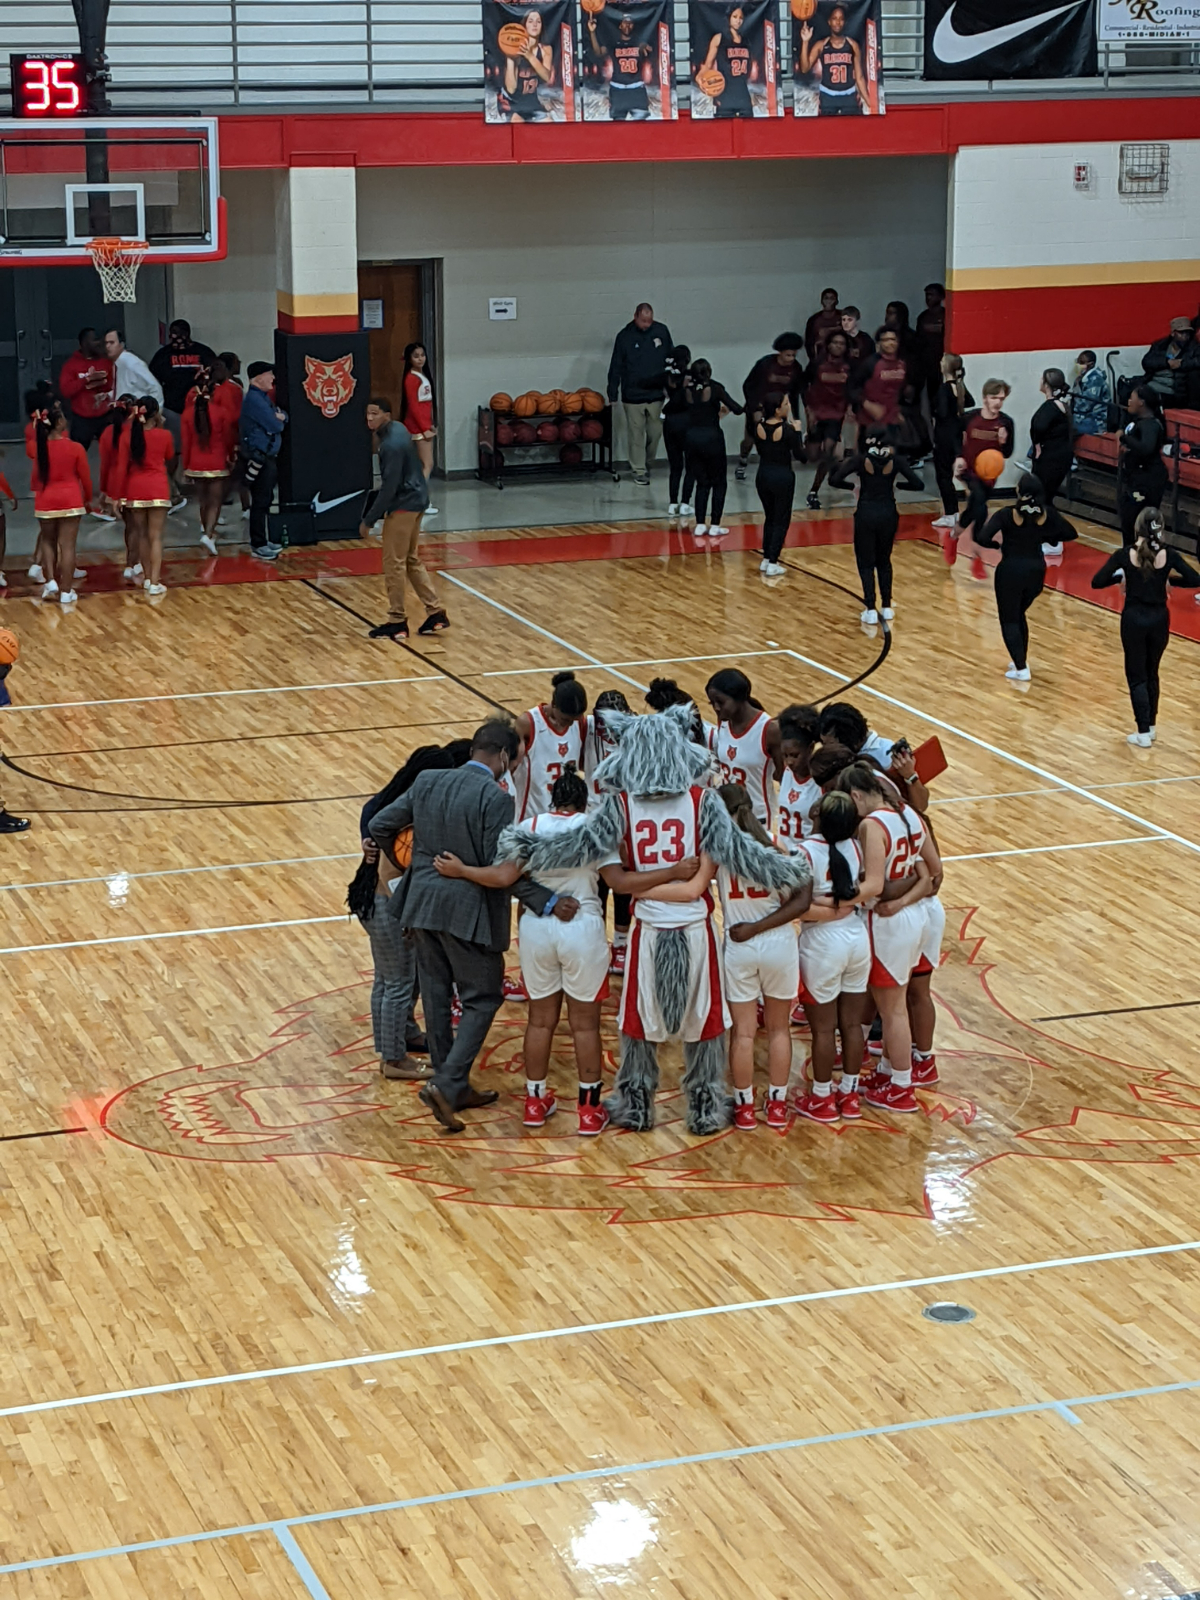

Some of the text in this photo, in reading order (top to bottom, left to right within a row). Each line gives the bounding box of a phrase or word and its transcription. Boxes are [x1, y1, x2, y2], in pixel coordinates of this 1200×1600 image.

[619, 58, 638, 73] 20
[731, 59, 747, 76] 24
[830, 65, 847, 83] 31
[25, 61, 79, 110] 35
[171, 355, 201, 365] ROME
[779, 806, 804, 839] 31
[635, 818, 685, 865] 23
